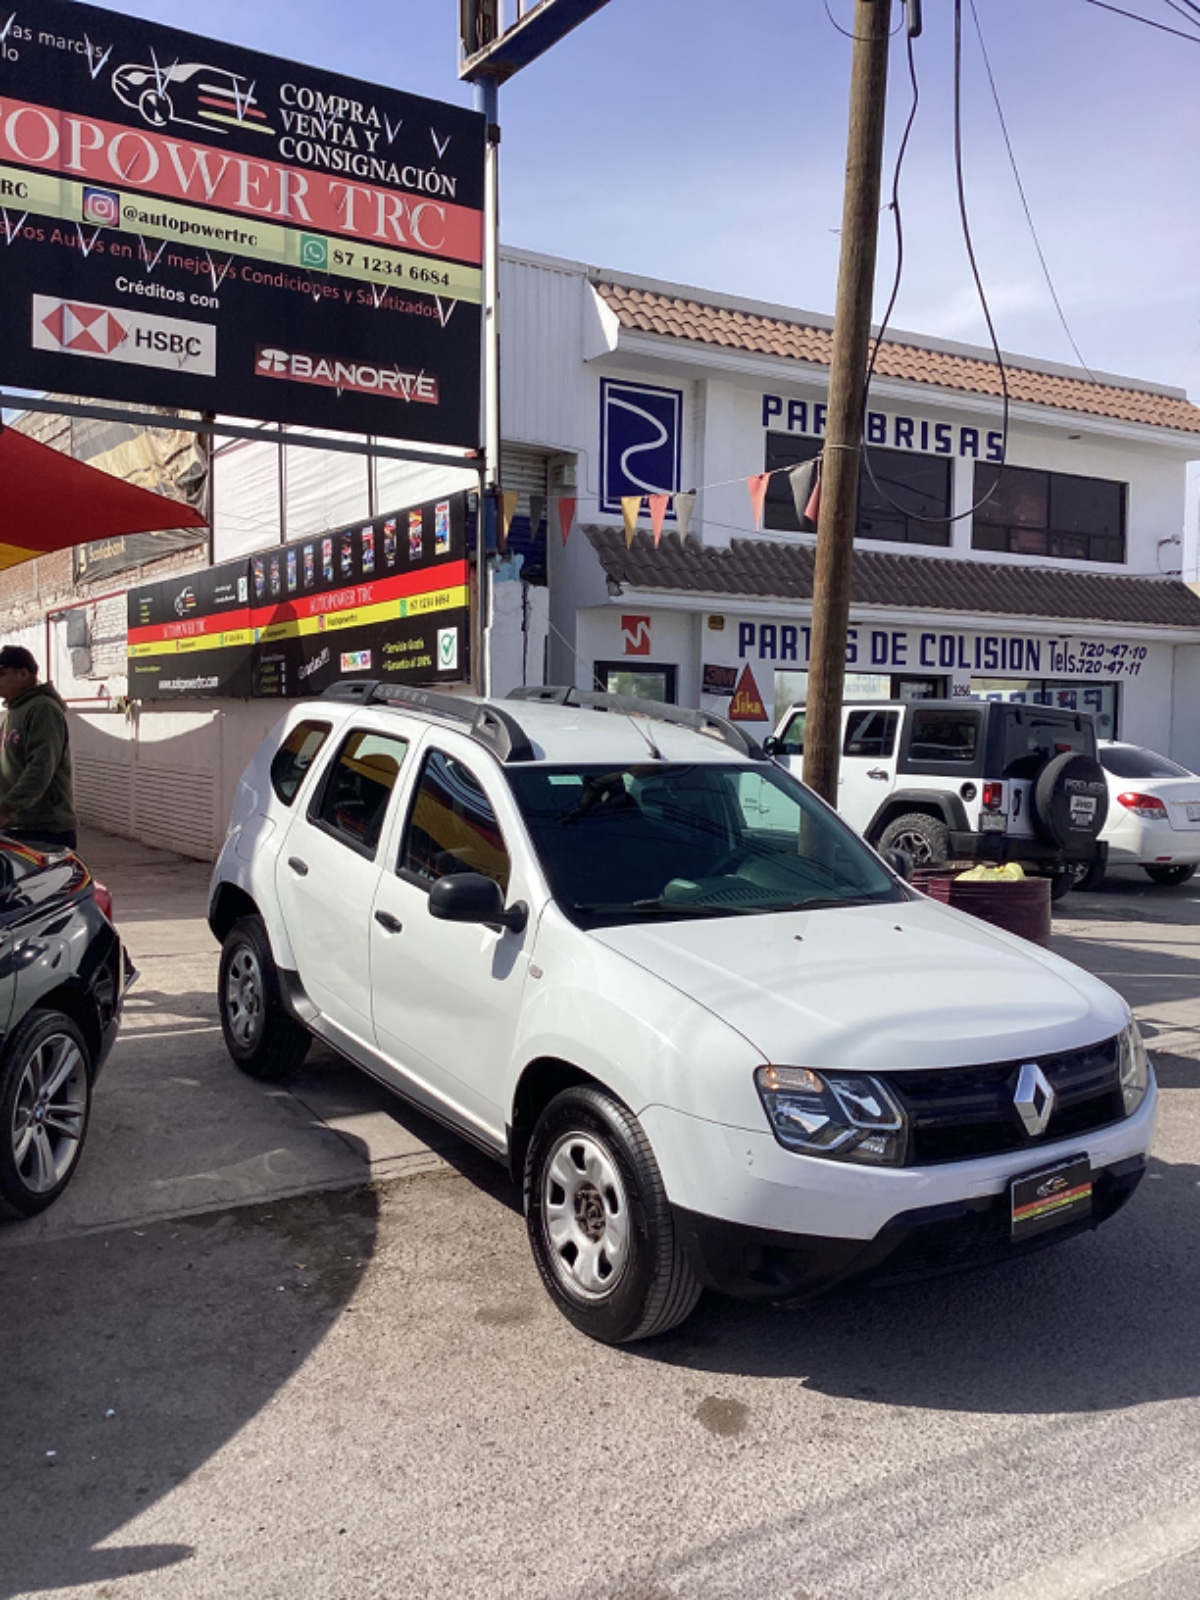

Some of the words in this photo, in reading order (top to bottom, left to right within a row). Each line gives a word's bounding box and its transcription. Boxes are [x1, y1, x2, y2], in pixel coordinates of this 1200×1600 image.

[38, 31, 103, 58] marcas
[279, 83, 382, 129] COMPRA
[280, 109, 357, 147] VENTA
[364, 131, 381, 153] Y
[0, 104, 314, 223] OPOWER
[329, 182, 447, 251] TRC
[278, 136, 457, 197] CONSIGNACIÓN
[50, 228, 104, 255] Autos
[110, 243, 133, 258] en
[168, 253, 237, 281] mejores
[241, 266, 339, 299] Condiciones
[344, 290, 353, 303] y
[122, 205, 259, 247] @autopowertrc
[332, 249, 355, 266] 87
[362, 256, 402, 277] 1234
[409, 266, 450, 286] 6684
[115, 275, 186, 304] Créditos
[190, 293, 220, 309] con
[135, 328, 202, 357] HSBC
[289, 353, 436, 400] BANORTE
[762, 393, 1004, 462] PARBRISAS
[739, 622, 858, 664] PARTS
[871, 631, 908, 666] DE
[920, 633, 1040, 672] COLISION
[733, 691, 762, 715] Sika
